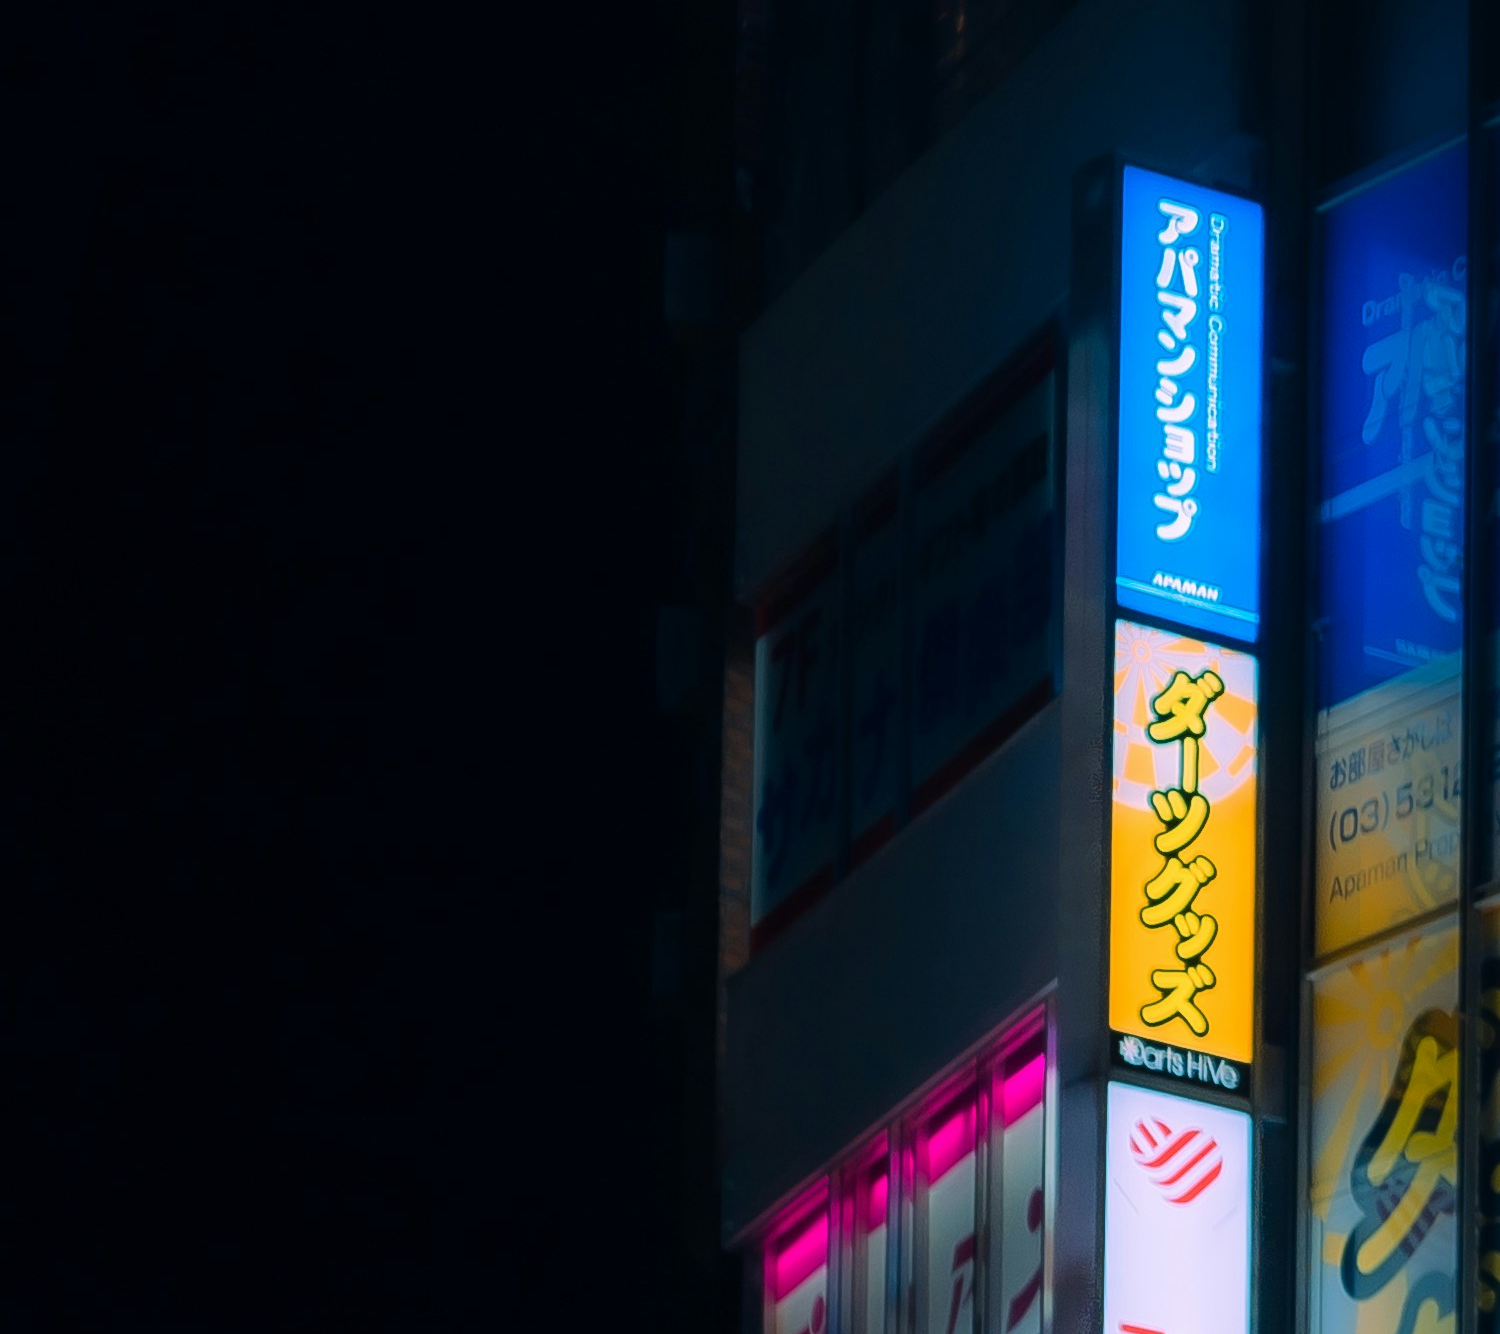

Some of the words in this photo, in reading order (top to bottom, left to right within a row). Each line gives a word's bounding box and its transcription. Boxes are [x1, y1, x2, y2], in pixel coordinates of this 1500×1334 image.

[1208, 213, 1225, 311] Dramatic
[1154, 199, 1199, 542] アパマンショップ
[1205, 315, 1225, 473] Communication
[1152, 572, 1219, 602] APAMAN
[1140, 669, 1225, 1037] ダーツグッズ
